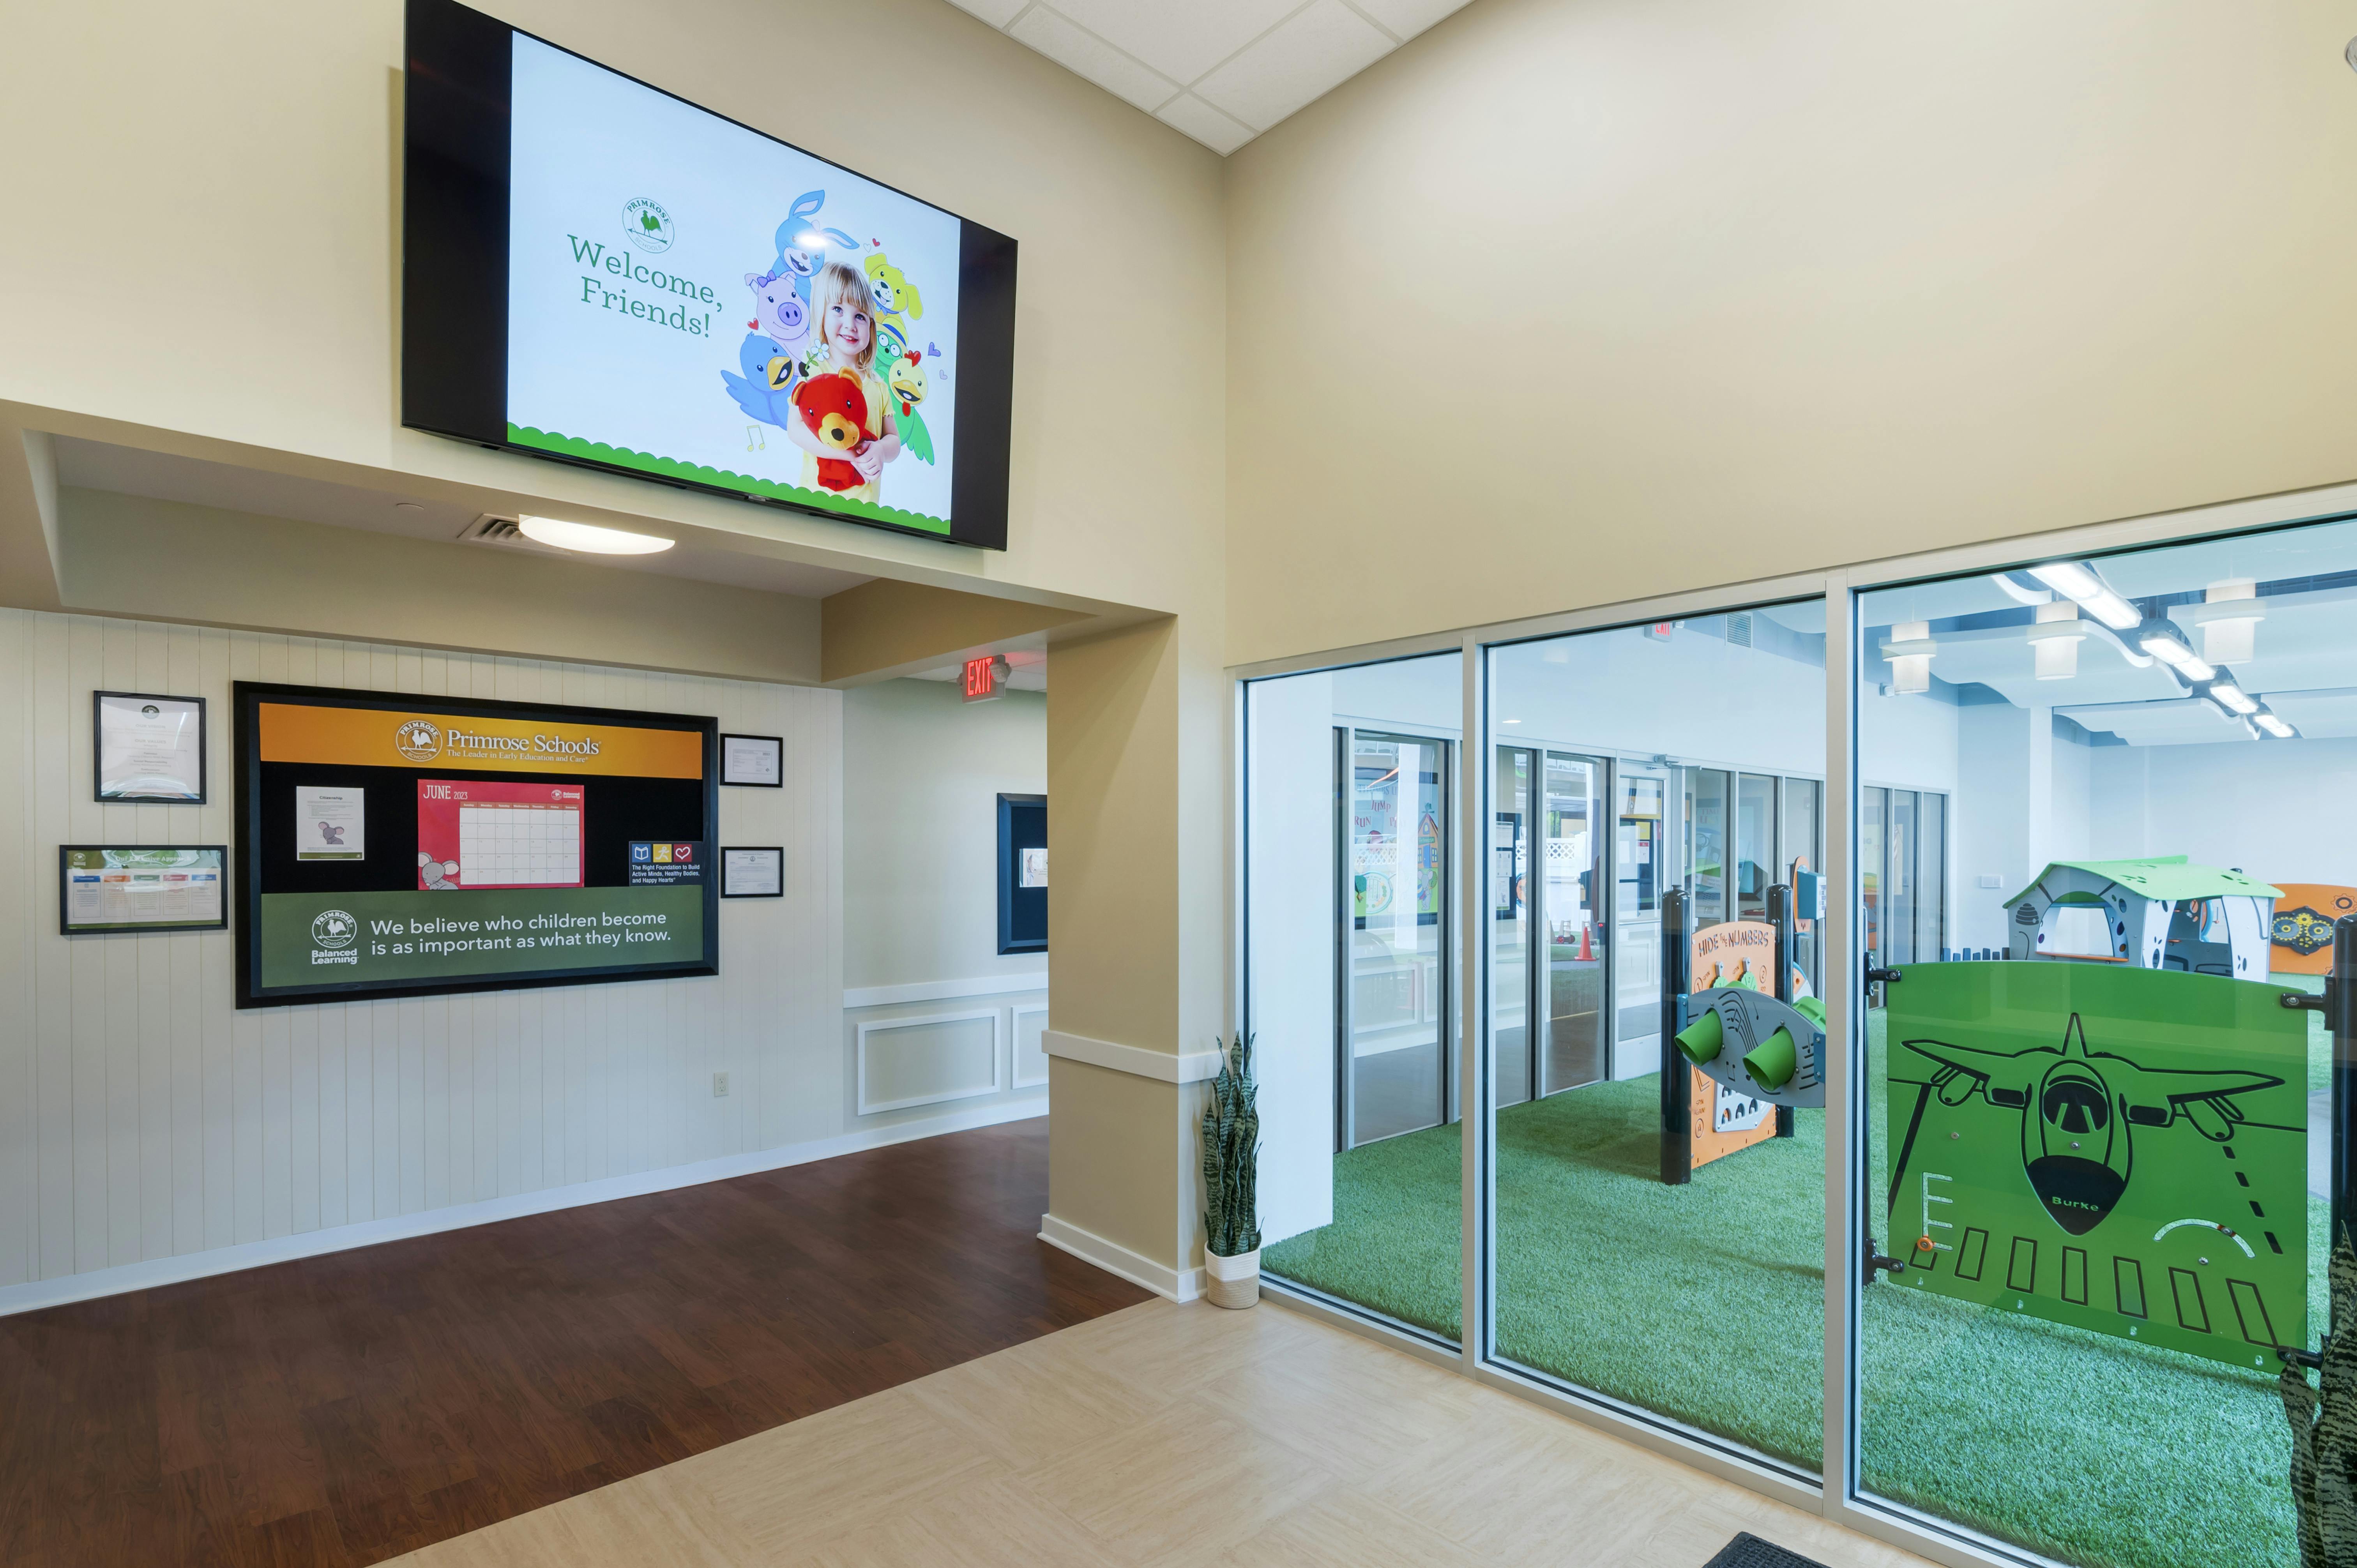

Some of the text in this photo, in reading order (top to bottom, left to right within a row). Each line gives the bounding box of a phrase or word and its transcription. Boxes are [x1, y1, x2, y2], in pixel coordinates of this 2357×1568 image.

[627, 199, 670, 225] PRIMROSE
[634, 237, 663, 251] SCHOOLS
[567, 234, 722, 312] Welcome,
[581, 276, 709, 337] Friends!
[967, 657, 993, 696] EXIT
[400, 722, 439, 737] PRIMROSE
[447, 729, 529, 751] Primrose
[407, 752, 432, 760] SCHOOLS
[463, 750, 487, 758] Leader
[499, 752, 517, 761] Early
[520, 752, 554, 761] Education
[423, 785, 468, 800] JUNE 2023
[1371, 800, 1391, 812] JUMP
[1355, 816, 1371, 827] RUN
[315, 912, 352, 925] PRIMROSE
[371, 912, 666, 935] We believe who children become
[372, 929, 671, 956] is as important as what they know.
[1698, 934, 1719, 957] HIDE
[1728, 930, 1769, 947] NUMBERS
[311, 948, 357, 958] Balanced
[311, 956, 357, 965] Learning
[2052, 1196, 2099, 1211] Burke
